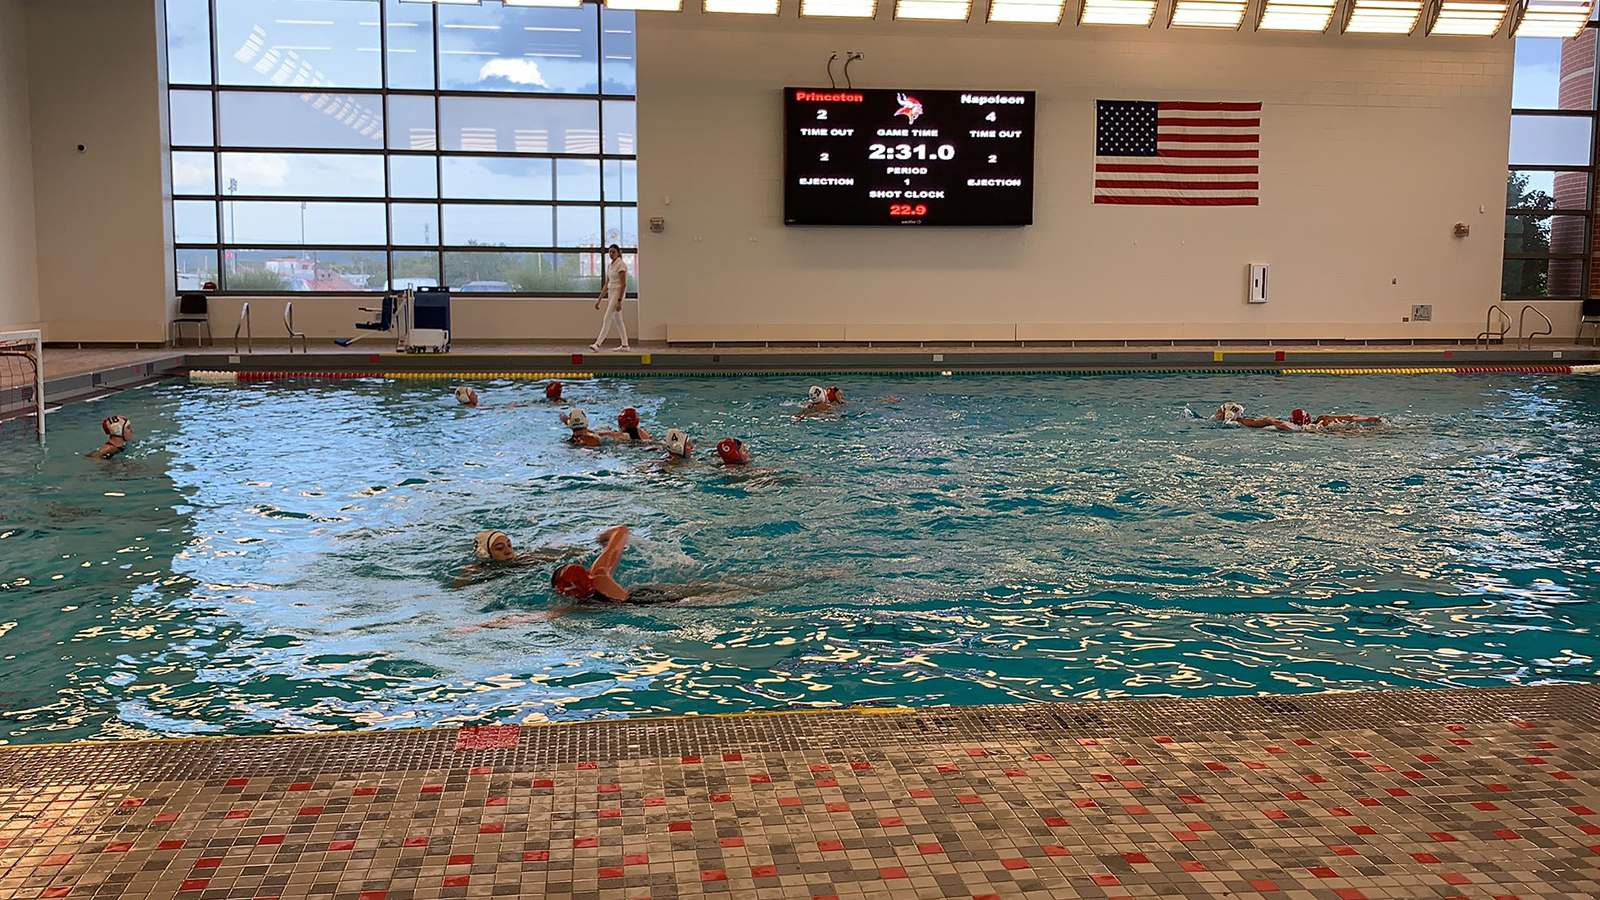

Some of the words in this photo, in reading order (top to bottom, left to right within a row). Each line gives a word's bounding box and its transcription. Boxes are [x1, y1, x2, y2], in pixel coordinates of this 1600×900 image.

[796, 91, 863, 102] Princeton
[960, 94, 1025, 105] Napoleon
[816, 109, 828, 120] 2
[985, 111, 997, 122] 4
[800, 128, 828, 136] TIME
[830, 128, 854, 136] OUT
[911, 129, 938, 137] TIME
[969, 130, 996, 138] TIME
[998, 130, 1022, 138] OUT
[819, 152, 829, 161] 2
[868, 144, 955, 160] 2:31.0
[988, 154, 998, 163] 2
[886, 167, 928, 175] PERIOD
[799, 178, 854, 186] EJECTION
[903, 178, 911, 186] 1
[967, 179, 1021, 187] EJECTION
[869, 190, 902, 198] SHOT
[904, 190, 945, 199] CLOCK
[890, 204, 927, 215] 22.9
[108, 415, 120, 424] 18
[671, 432, 679, 442] 4
[721, 443, 731, 452] 6
